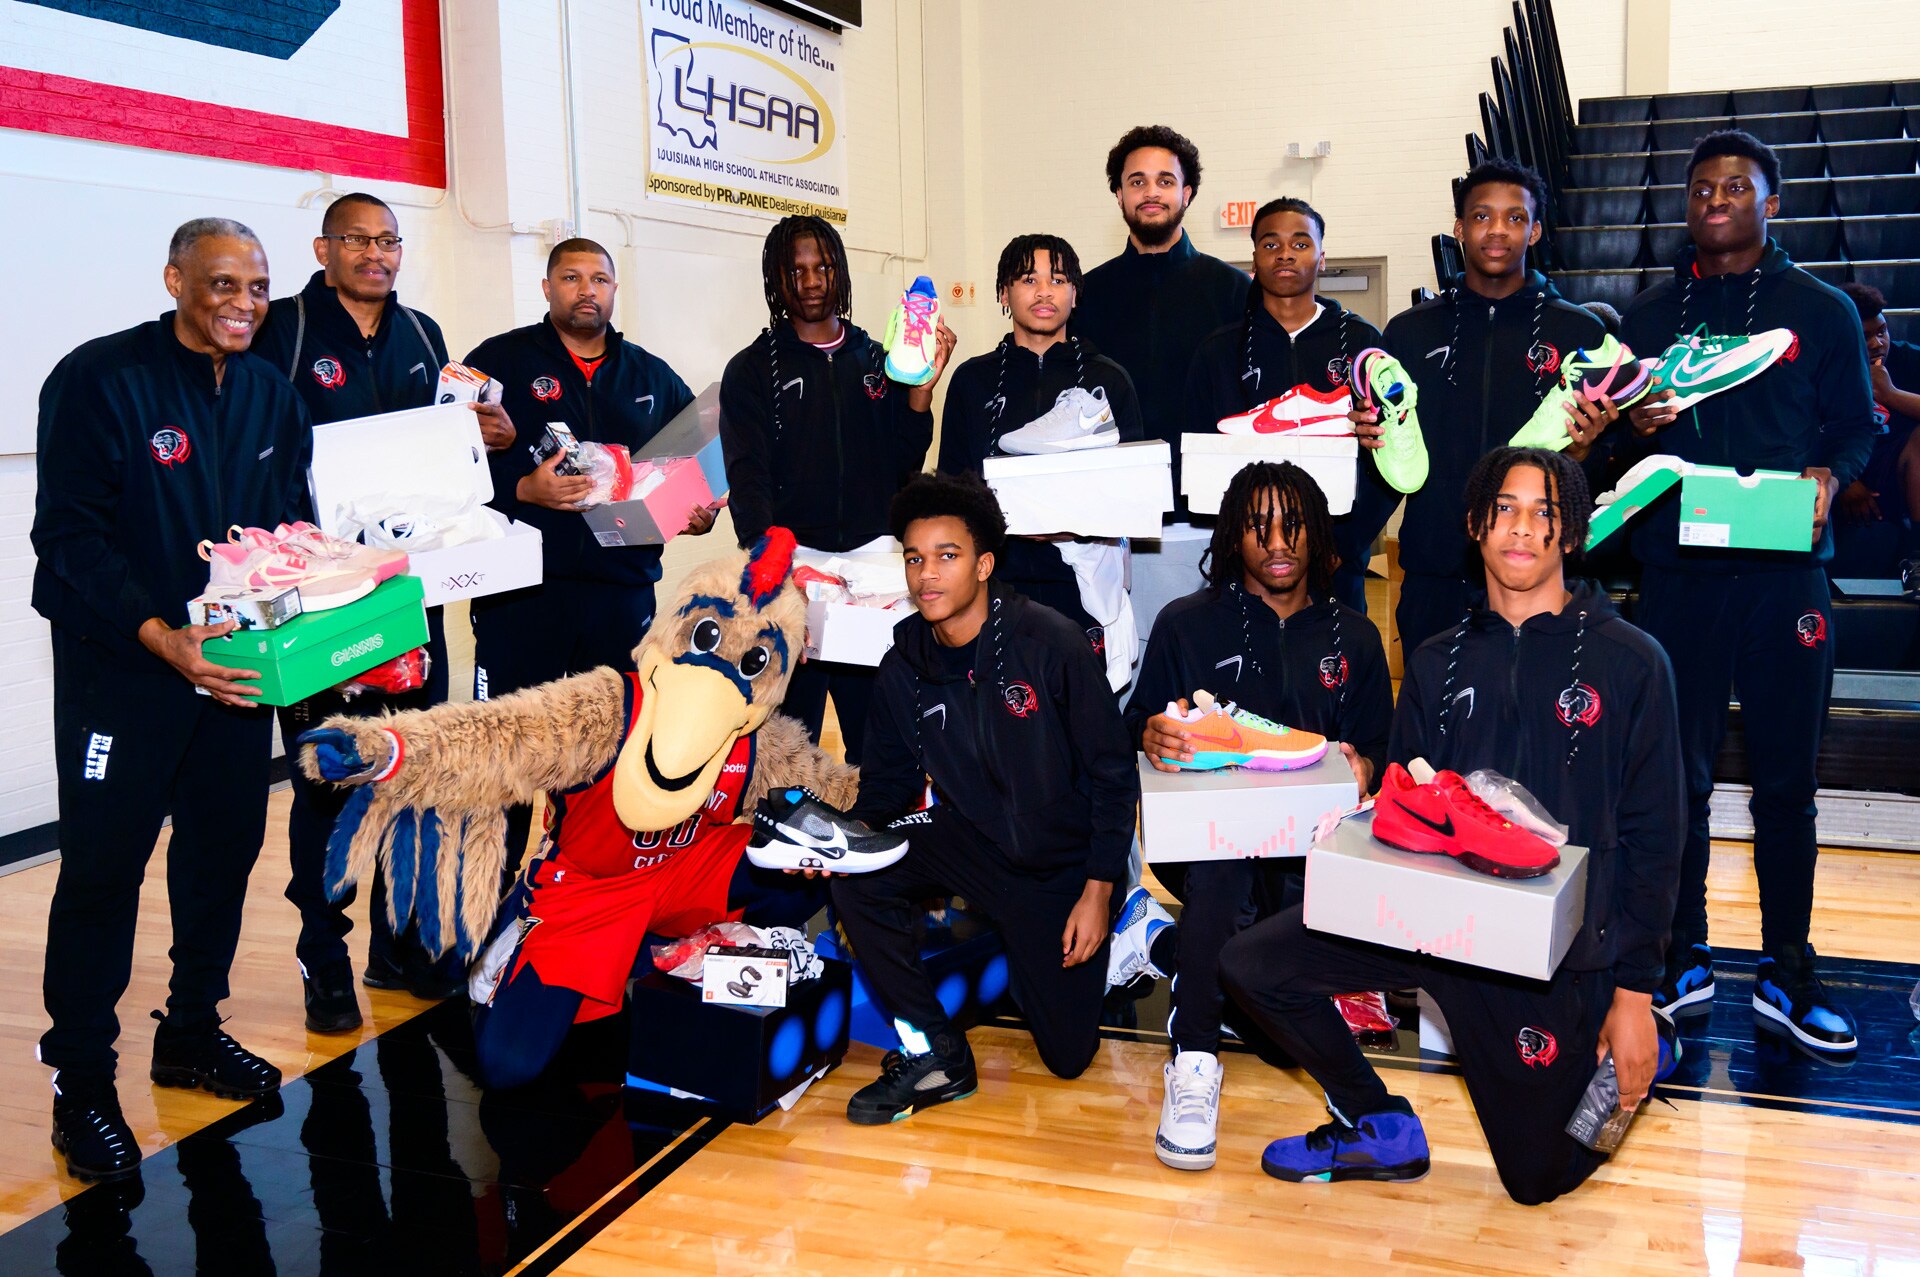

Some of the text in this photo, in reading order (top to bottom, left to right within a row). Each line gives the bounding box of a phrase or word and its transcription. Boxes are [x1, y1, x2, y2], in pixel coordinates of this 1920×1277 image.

[650, 0, 835, 71] oud Member of the...
[674, 65, 820, 144] LHSAA
[657, 147, 840, 196] LOUISIANA HIGH SCHOOL ATHLETIC ASSOCIATION
[648, 175, 847, 222] Sponsored by PROPANE Dealers of Louisiana
[1227, 202, 1256, 226] EXIT
[331, 633, 384, 667] GIANNIS
[84, 732, 113, 780] ELITE
[887, 811, 933, 829] ELITE
[633, 853, 675, 869] CIT
